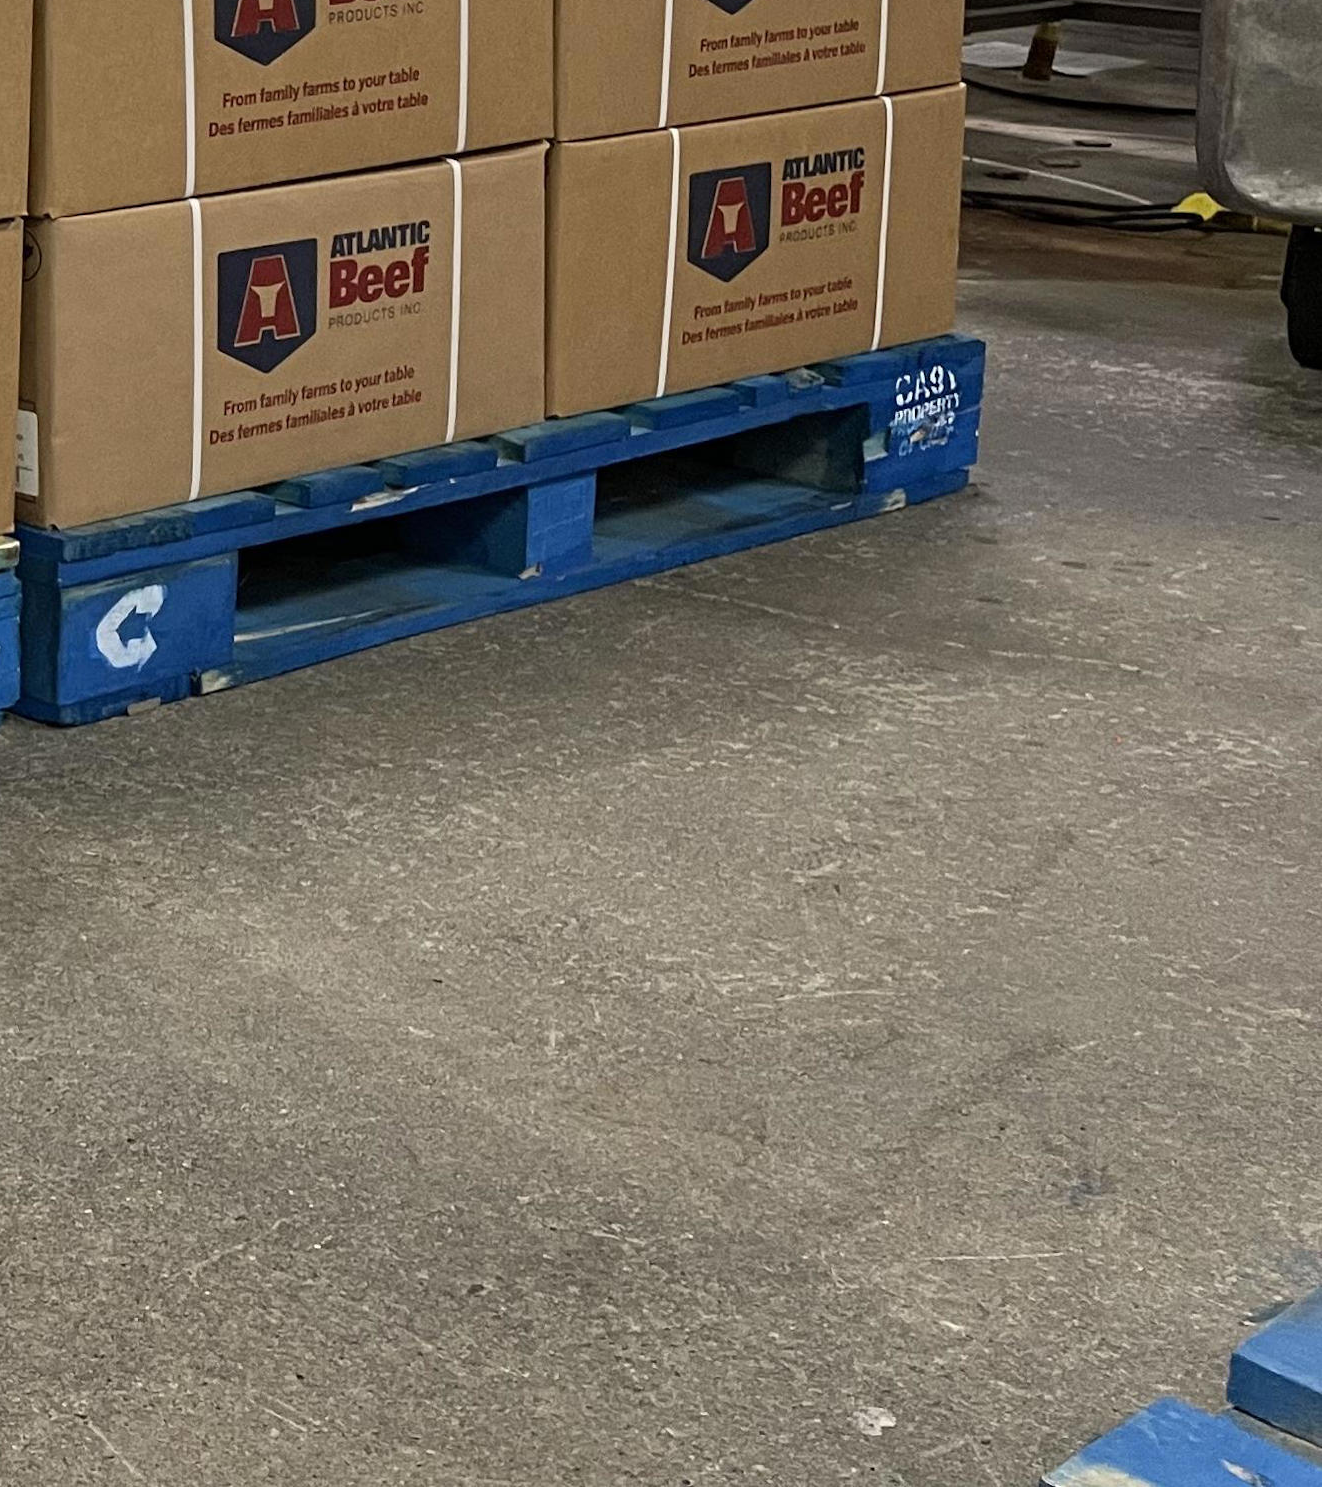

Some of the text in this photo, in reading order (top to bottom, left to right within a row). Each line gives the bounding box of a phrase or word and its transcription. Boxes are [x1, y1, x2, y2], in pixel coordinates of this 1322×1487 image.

[328, 4, 397, 26] PRODUCTS
[781, 147, 865, 181] ATLANTIC
[780, 169, 865, 227] Beef
[330, 219, 430, 259] ATLANTIC
[328, 244, 430, 310] Beef
[328, 305, 394, 330] PRODUCTS
